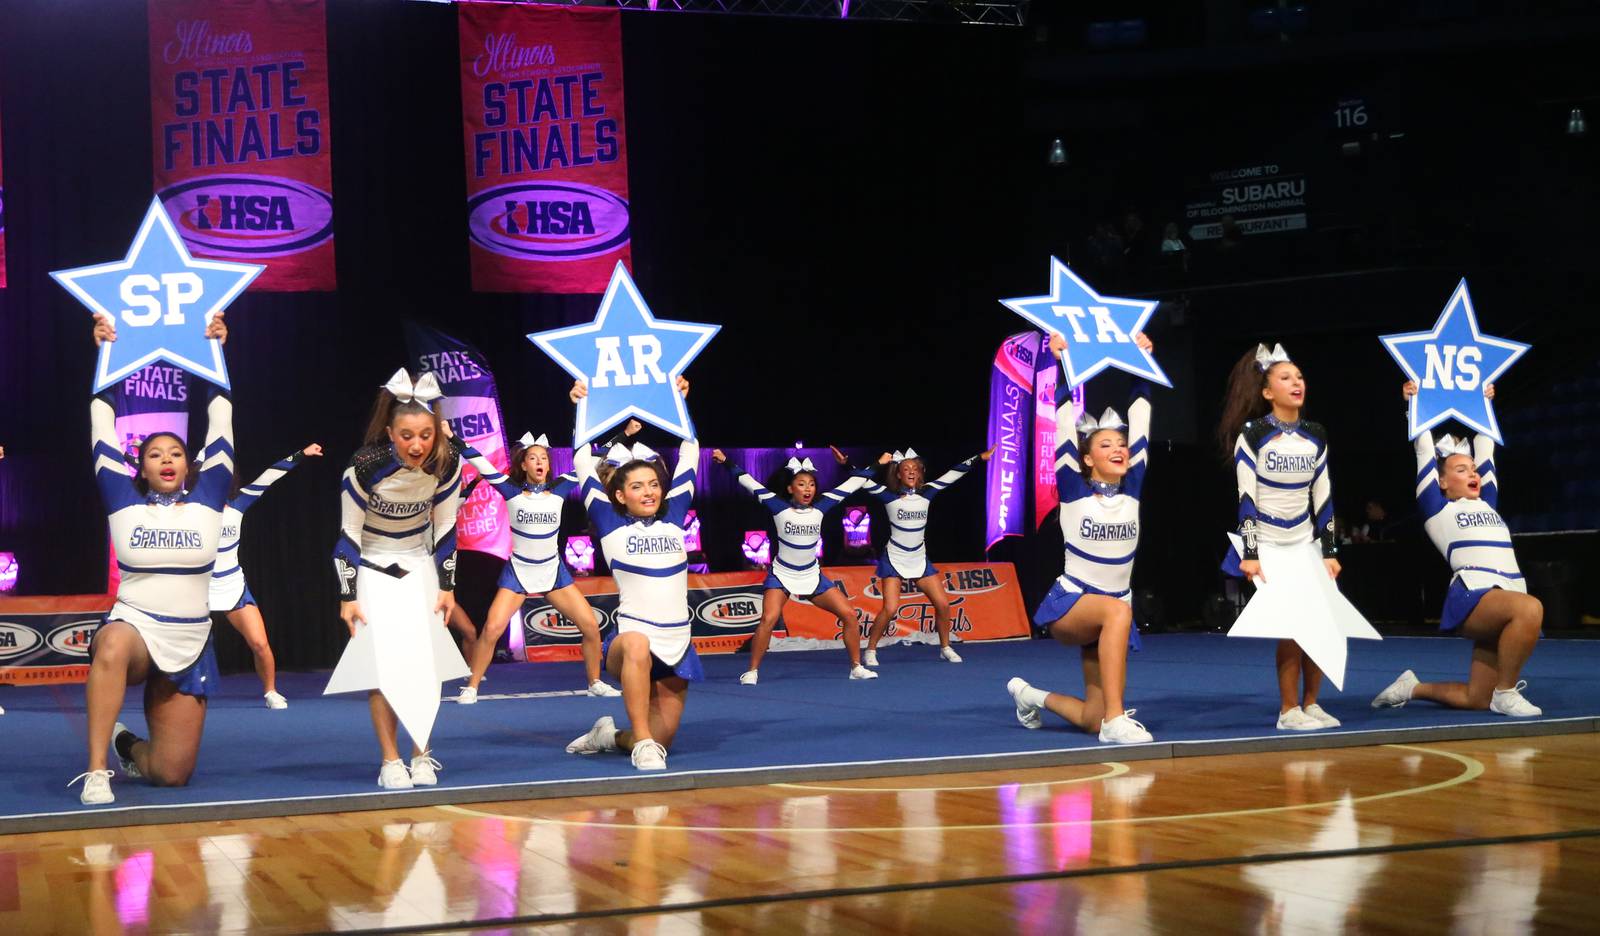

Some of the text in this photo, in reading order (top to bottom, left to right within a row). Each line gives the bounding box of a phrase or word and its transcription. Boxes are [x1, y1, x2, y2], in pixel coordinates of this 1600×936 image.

[163, 20, 254, 64] Illinois
[473, 33, 555, 77] Illinois
[174, 61, 306, 117] STATE
[483, 72, 606, 127] STATE
[1334, 105, 1369, 128] 116
[163, 109, 320, 170] FINALS
[474, 118, 620, 177] FINALS
[1264, 165, 1279, 175] TO
[1222, 179, 1305, 204] SUBARU
[119, 272, 204, 327] SP
[1051, 305, 1131, 343] TA
[419, 351, 470, 371] STATE
[591, 334, 667, 388] AR
[1421, 343, 1482, 391] NS
[125, 379, 188, 401] FINALS
[448, 412, 494, 439] HSA
[1001, 384, 1020, 464] FINALS
[1264, 450, 1316, 473] SPARTANS
[517, 509, 557, 524] SPARTANS
[897, 509, 928, 521] SPARTANS
[1455, 512, 1506, 529] SPARTA
[130, 525, 203, 549] SPARTANS
[784, 521, 820, 536] SPARTANS
[1080, 516, 1137, 541] SPARTANS
[627, 535, 683, 555] SPARTANS
